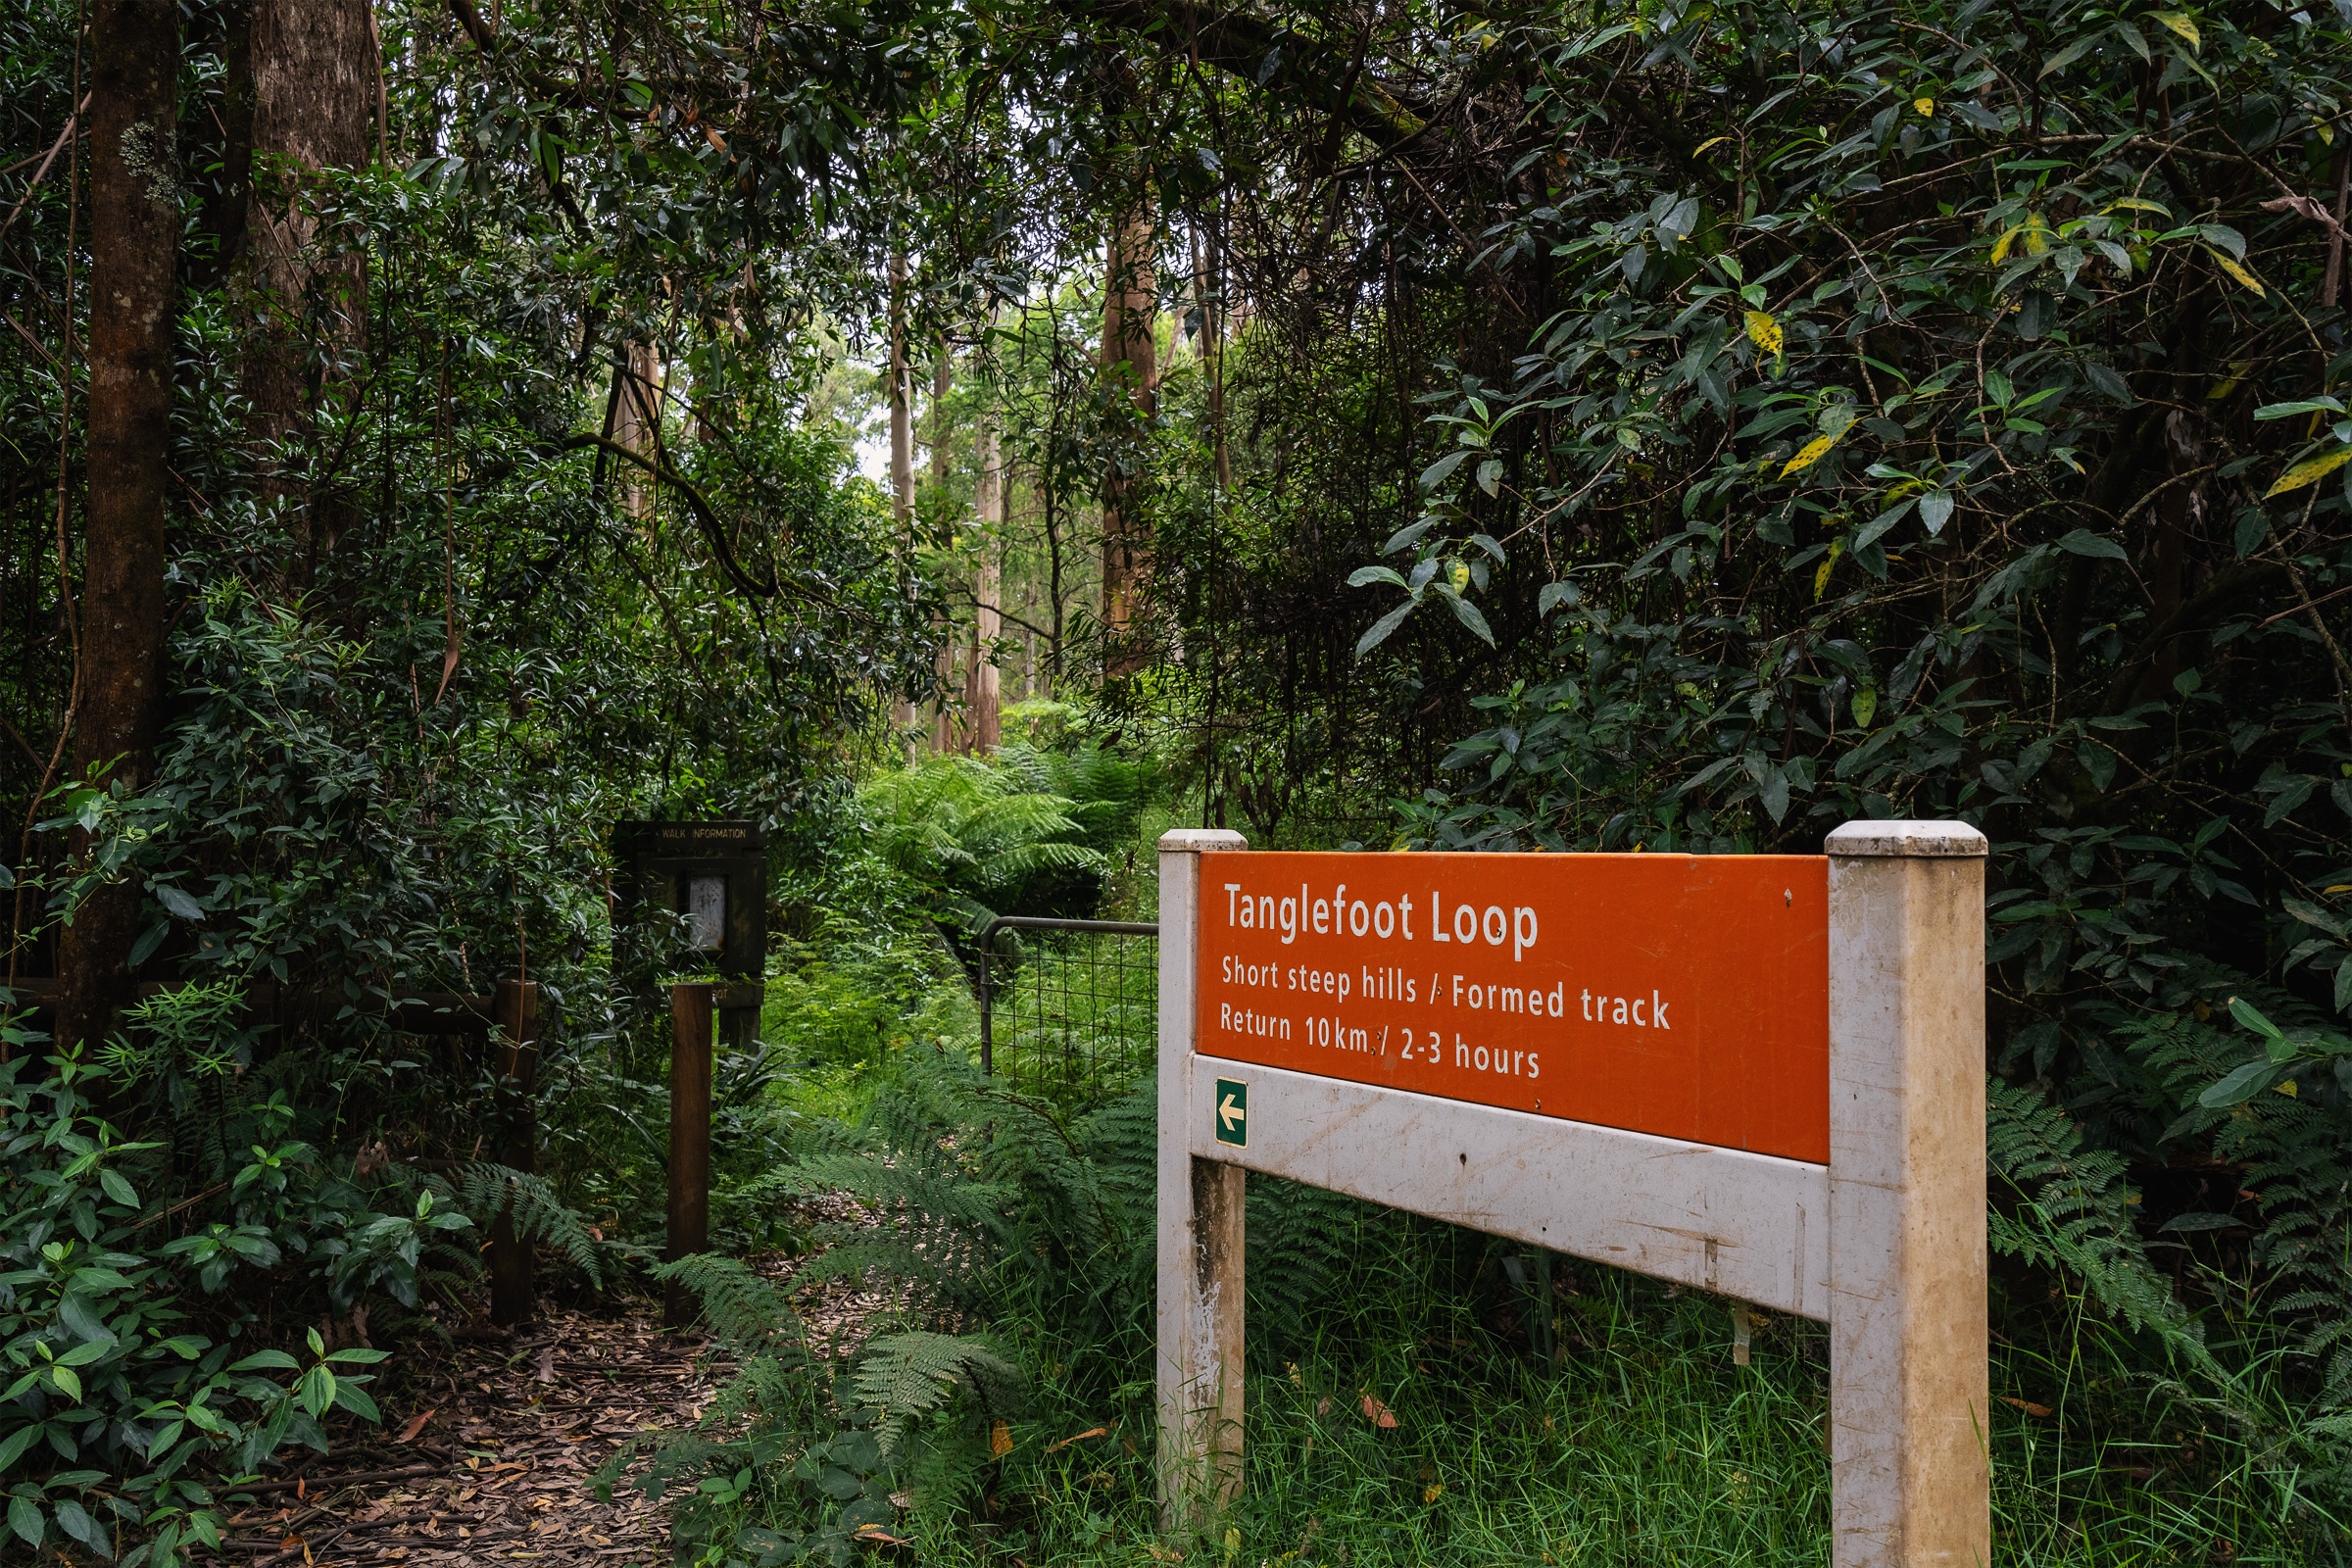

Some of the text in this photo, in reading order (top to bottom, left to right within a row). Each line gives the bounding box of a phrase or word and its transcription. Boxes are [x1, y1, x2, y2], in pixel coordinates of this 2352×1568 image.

[662, 828, 746, 838] WALK INFORMATION
[1224, 883, 1539, 962] Tanglefoot Loop
[1222, 955, 1671, 1030] Short steep hills / Formed track
[1220, 1003, 1291, 1041] Return
[1305, 1016, 1368, 1053] 10km
[1401, 1027, 1441, 1064] 2-3
[1455, 1033, 1540, 1079] hours
